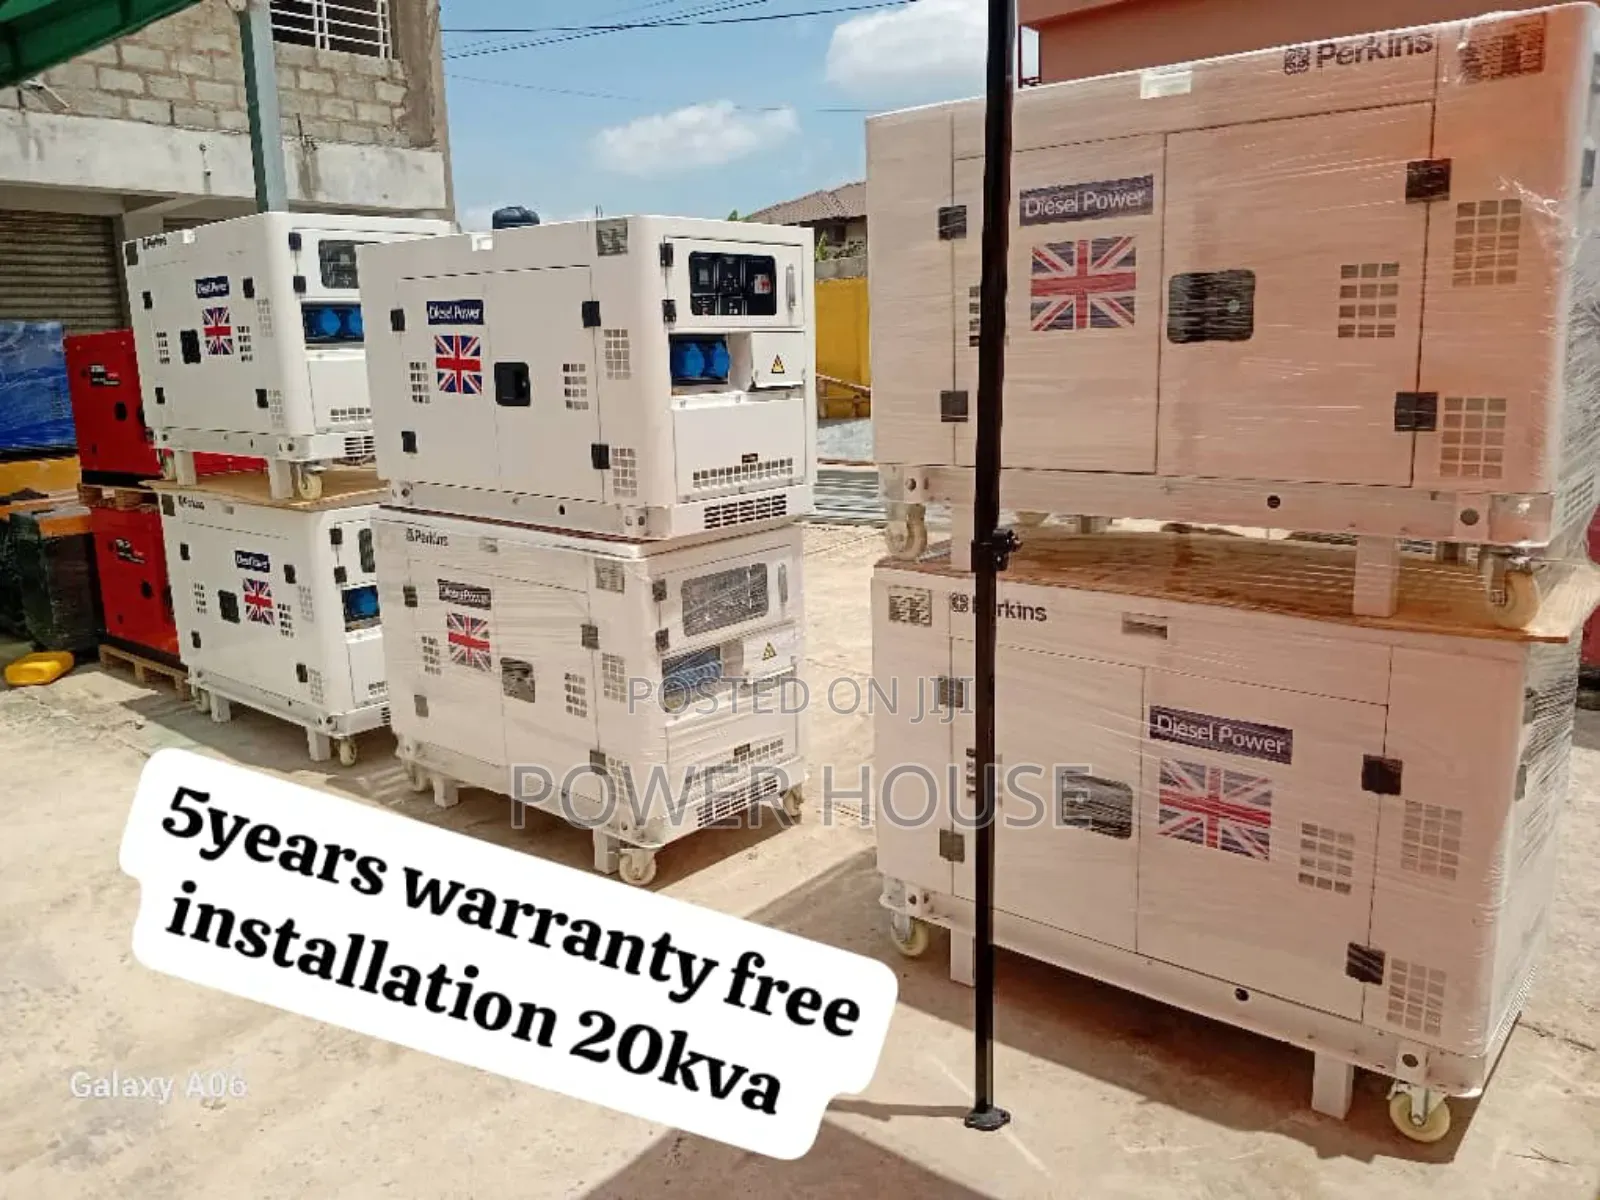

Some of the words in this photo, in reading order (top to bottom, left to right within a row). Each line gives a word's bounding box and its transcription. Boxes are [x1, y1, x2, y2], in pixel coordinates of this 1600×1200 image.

[1317, 32, 1433, 68] Perkins
[1024, 189, 1079, 218] Diesel
[1083, 188, 1146, 212] Power
[971, 596, 1047, 622] rkins
[1156, 714, 1214, 742] Diesel
[1217, 724, 1286, 754] Power
